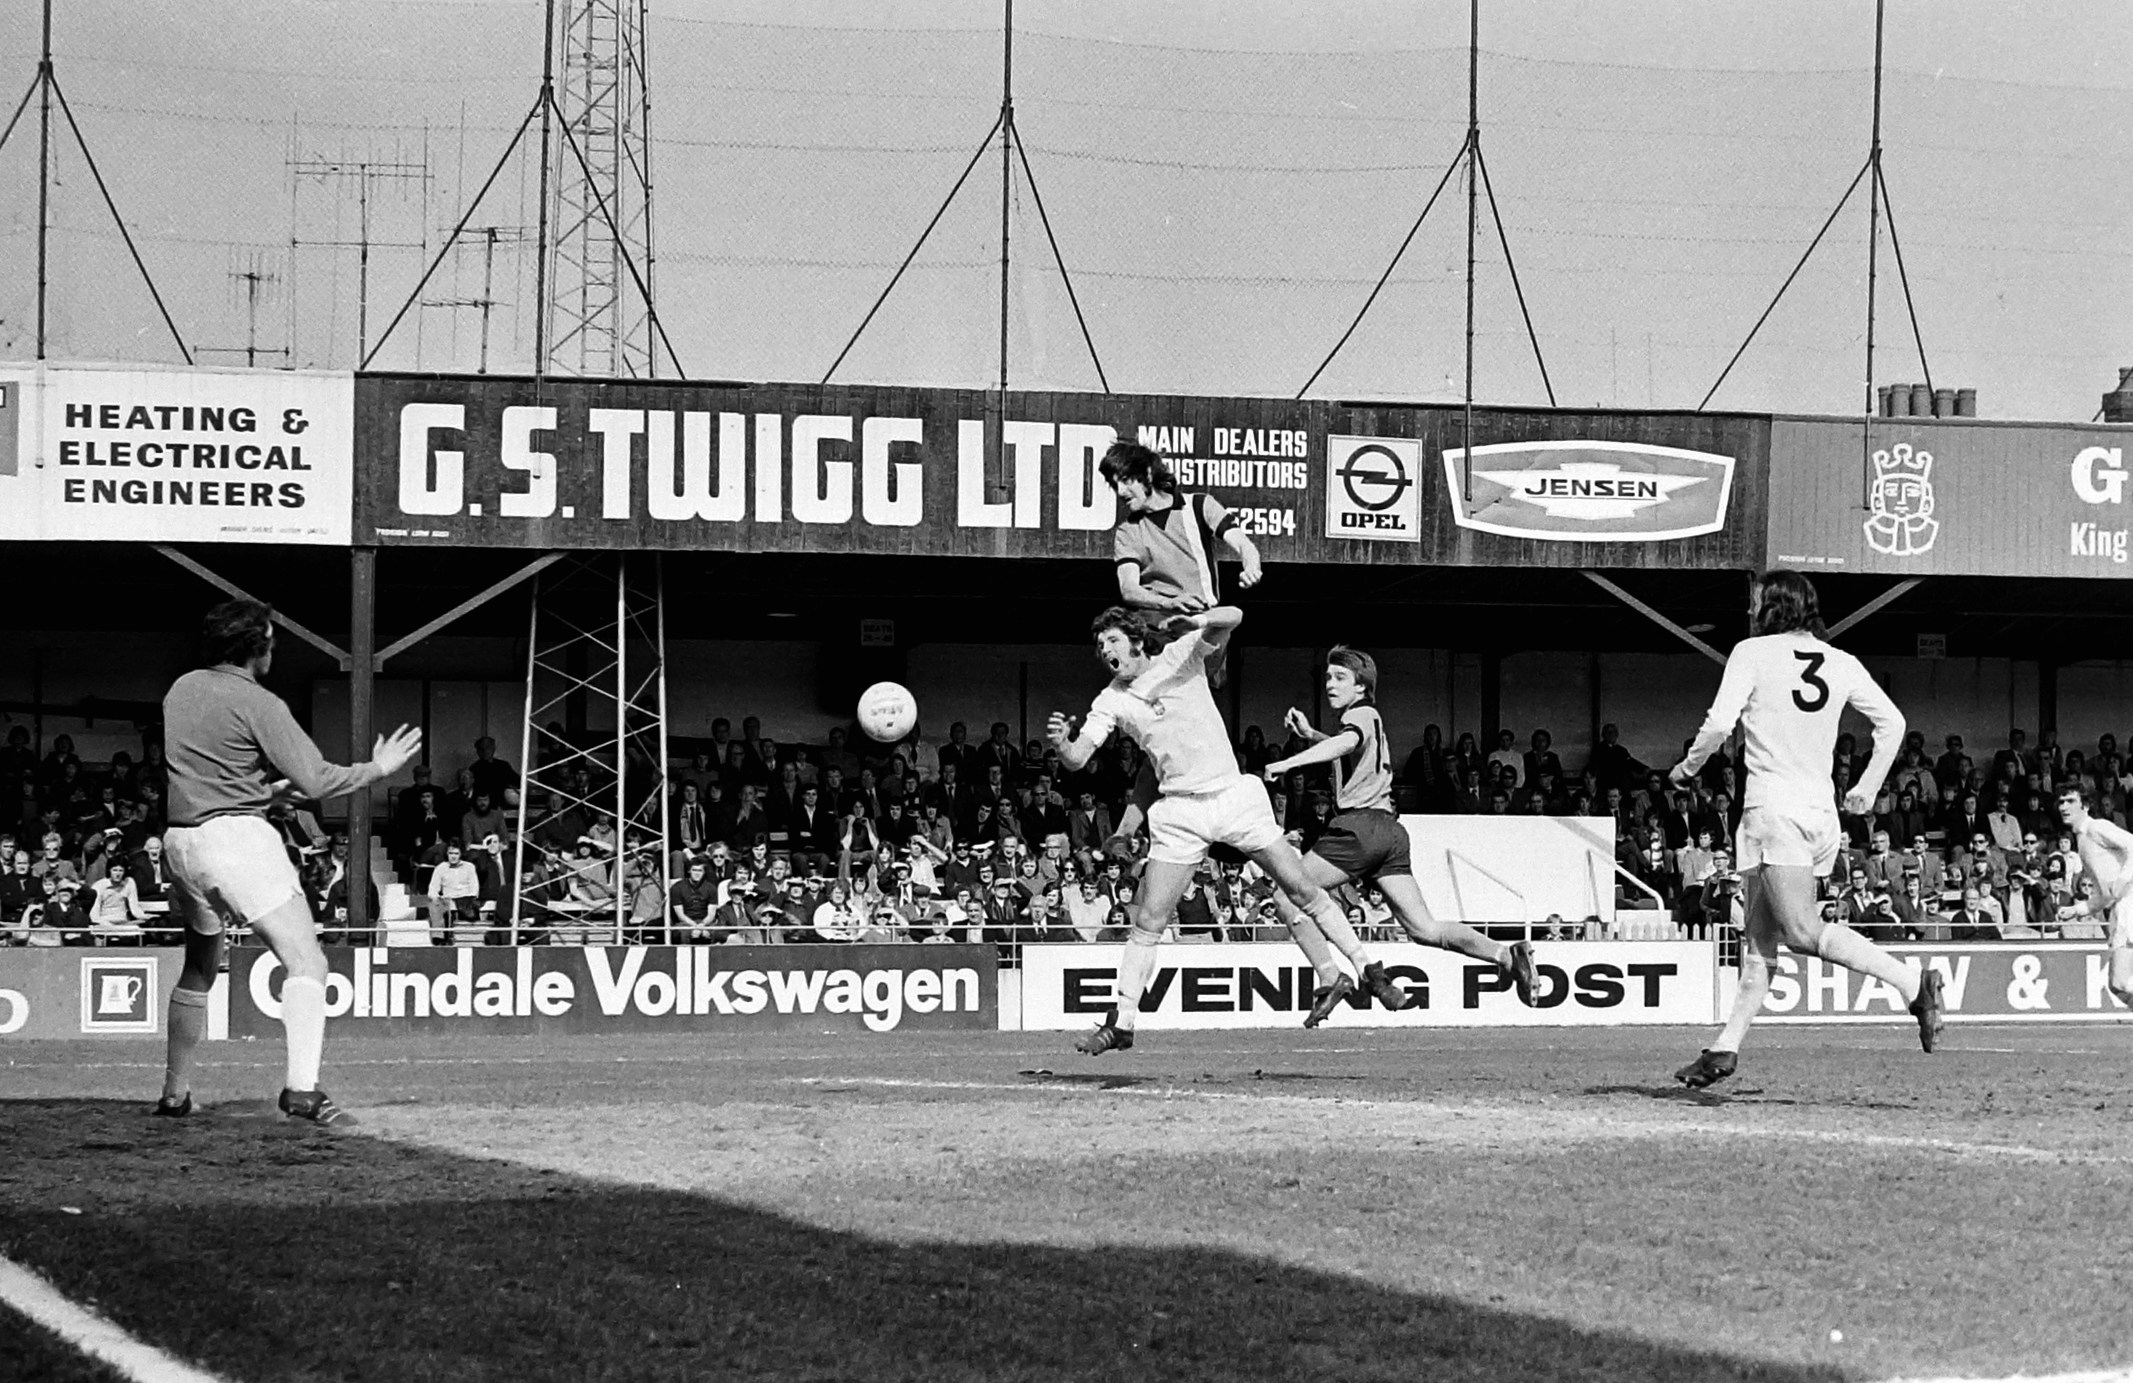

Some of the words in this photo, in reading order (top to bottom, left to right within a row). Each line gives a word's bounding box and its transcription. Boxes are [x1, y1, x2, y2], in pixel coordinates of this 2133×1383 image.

[65, 403, 257, 432] HEATING
[282, 408, 309, 434] &
[59, 440, 312, 471] ELECTRICAL
[1137, 425, 1194, 454] MAIN
[1214, 427, 1308, 458] DEALERS
[588, 408, 923, 526] TWIGG
[957, 420, 1118, 531] LTD
[1524, 478, 1658, 499] JENSEN
[2070, 446, 2129, 505] G
[64, 478, 306, 509] ENGINEERS
[1340, 512, 1407, 530] OPEL
[2070, 522, 2129, 565] King
[1791, 649, 1830, 713] 3
[248, 946, 575, 1017] Colindale
[585, 945, 979, 1032] Volkswagen
[1462, 962, 1678, 1010] POST
[1761, 954, 1972, 1013] SHAW
[2006, 953, 2052, 1011] &
